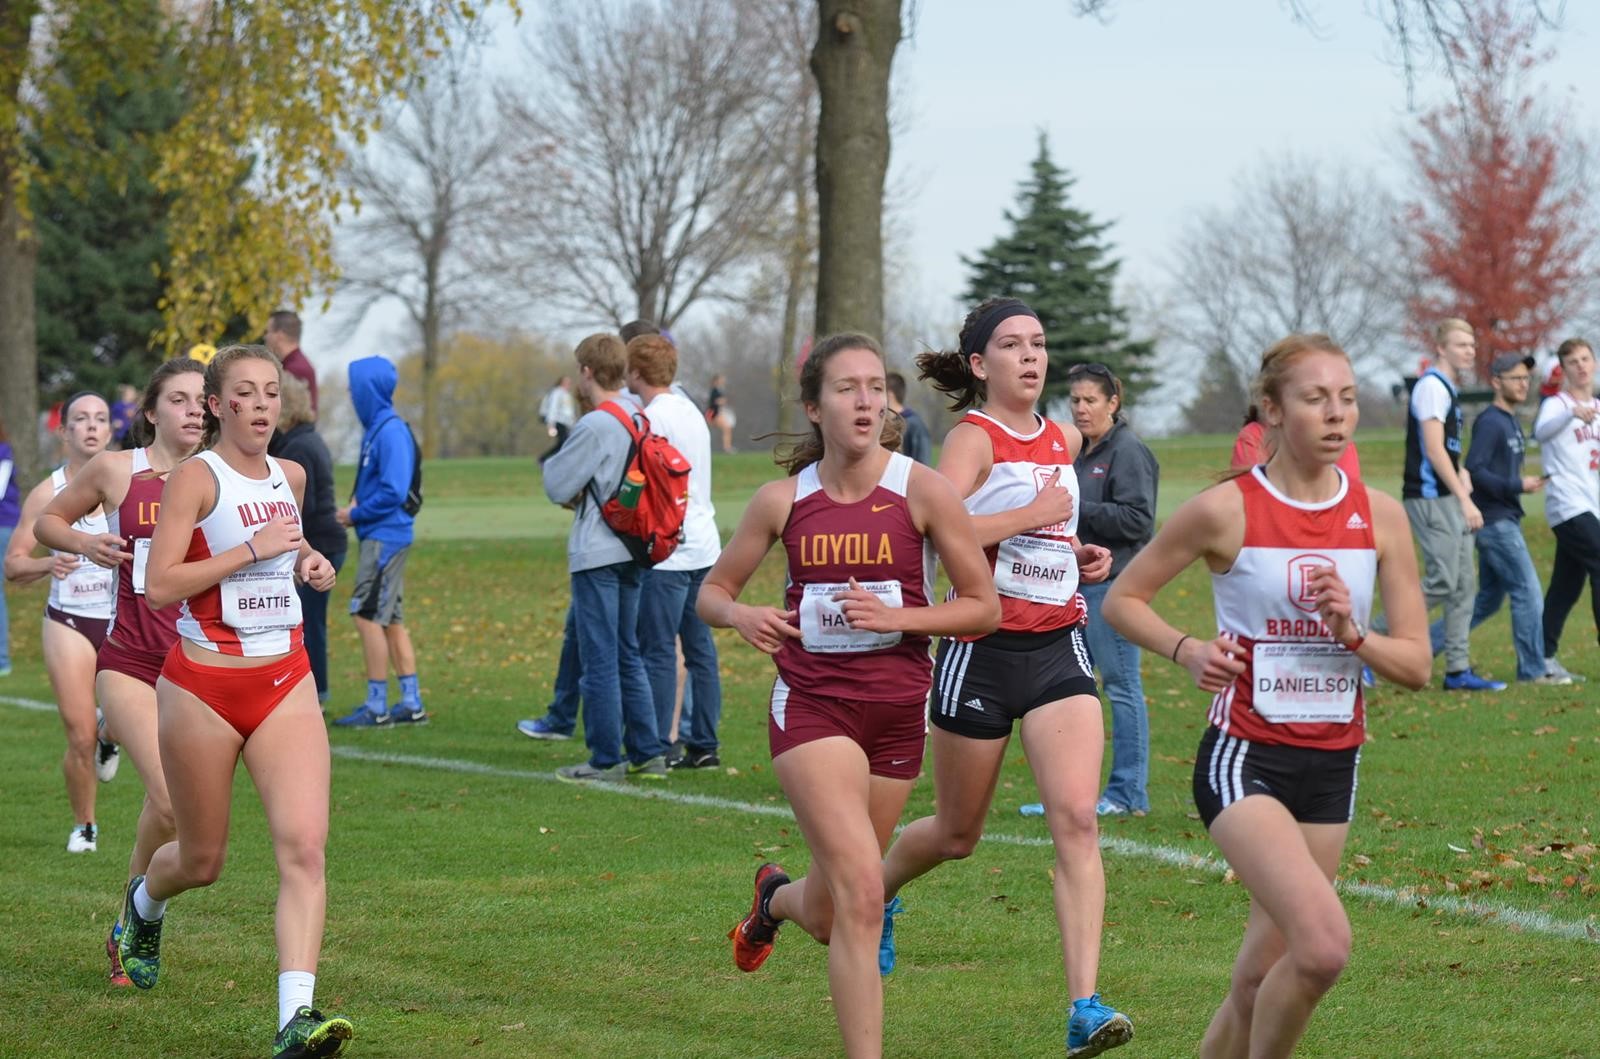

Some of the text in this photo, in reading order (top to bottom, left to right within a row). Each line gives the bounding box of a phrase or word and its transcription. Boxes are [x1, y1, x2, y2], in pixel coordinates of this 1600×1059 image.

[801, 533, 893, 567] LOYOLA
[1028, 539, 1055, 548] MISSOURI
[1012, 562, 1067, 582] BURANT
[73, 581, 108, 594] ALLEN
[238, 595, 291, 610] BEATTIE
[822, 613, 845, 627] HA
[1266, 618, 1329, 637] BRADL
[1259, 677, 1359, 693] DANIELSON
